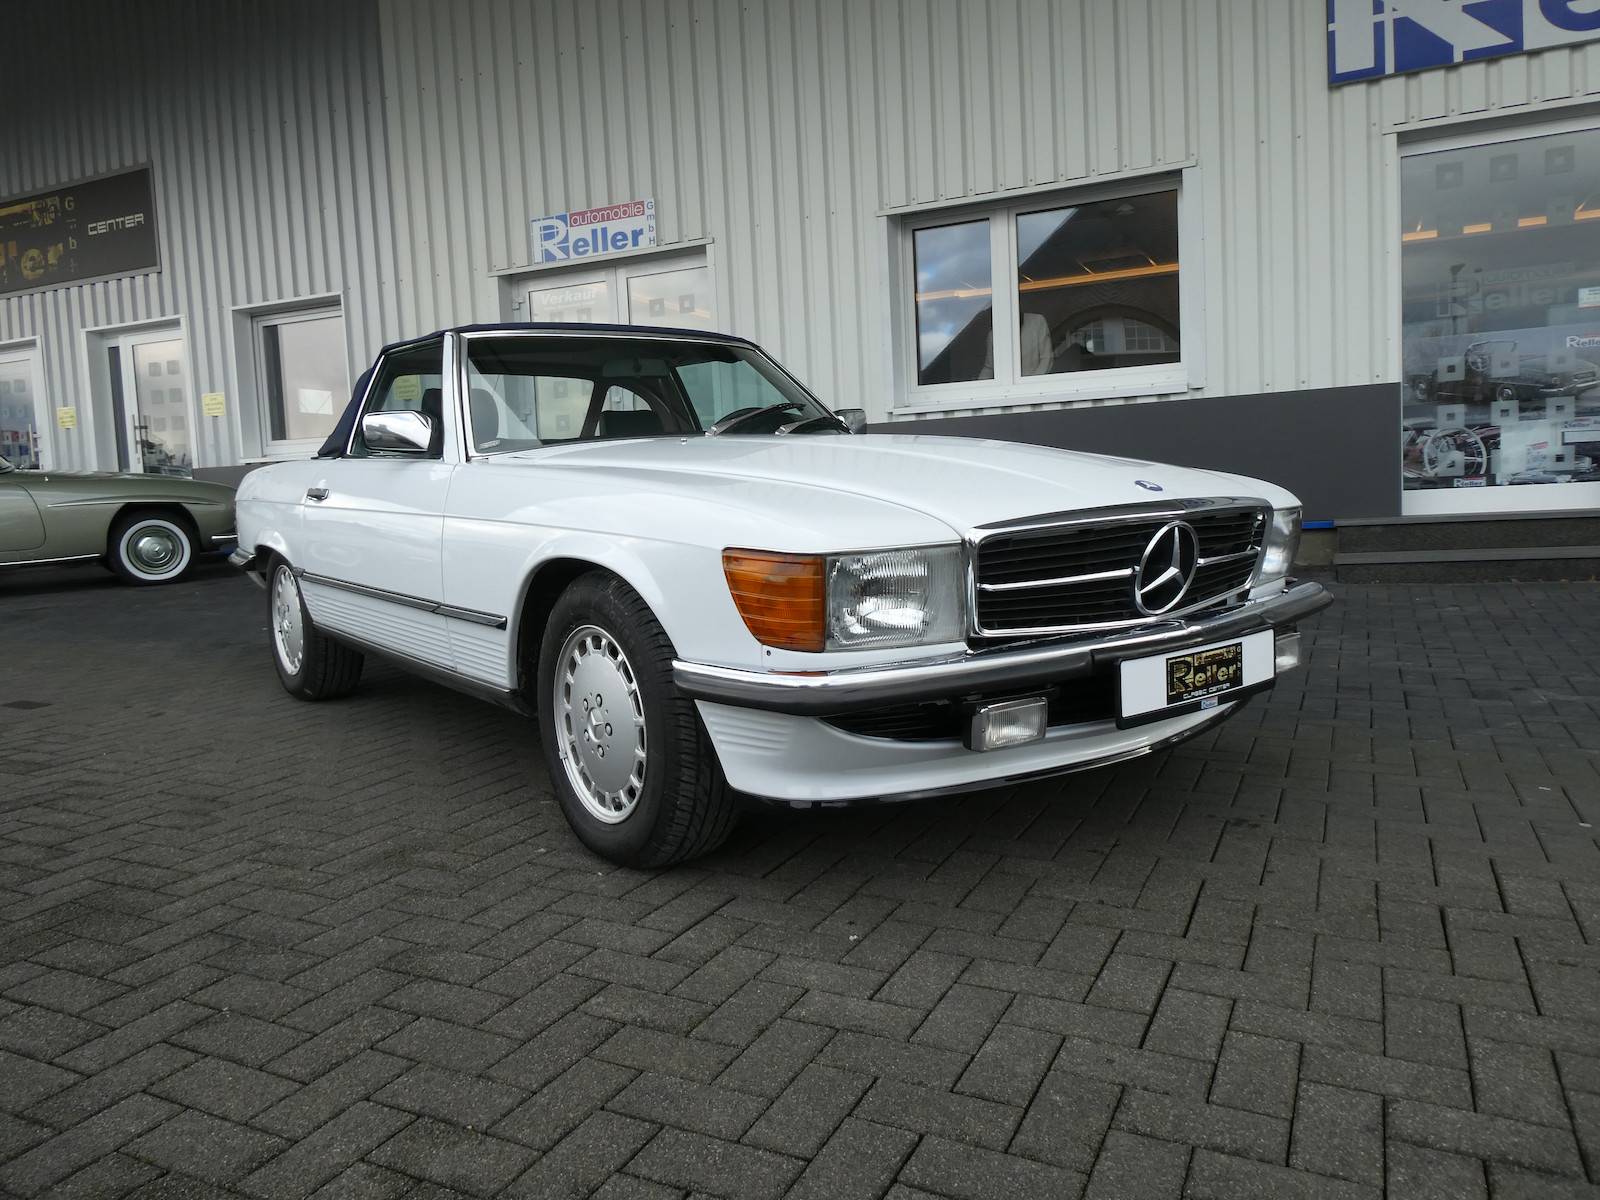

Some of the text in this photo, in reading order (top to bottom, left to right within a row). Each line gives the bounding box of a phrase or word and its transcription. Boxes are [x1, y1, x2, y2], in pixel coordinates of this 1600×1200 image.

[87, 212, 145, 236] CENTER
[570, 203, 644, 227] automobile
[646, 201, 656, 245] GmbH
[532, 219, 644, 263] Reller
[1168, 656, 1237, 695] Reller
